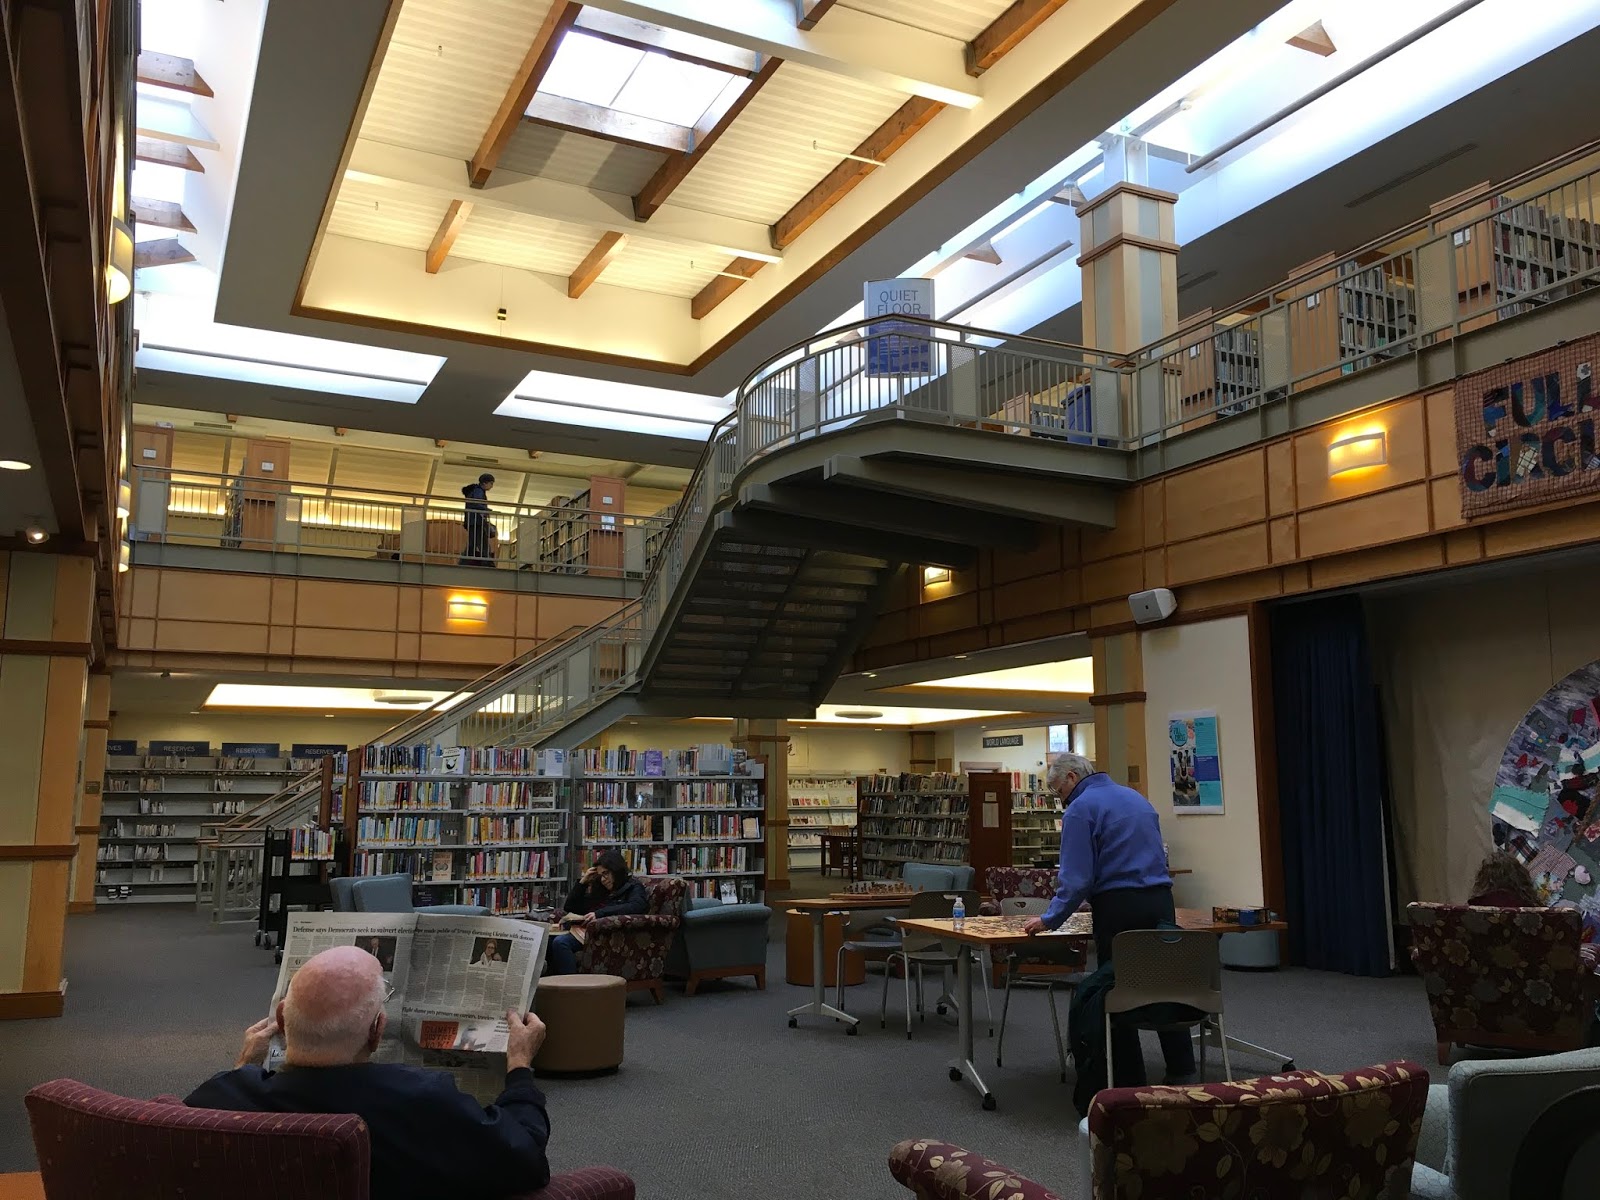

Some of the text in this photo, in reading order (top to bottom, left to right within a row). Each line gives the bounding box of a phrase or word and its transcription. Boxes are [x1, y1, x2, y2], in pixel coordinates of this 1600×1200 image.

[879, 290, 919, 303] QUIET
[877, 303, 922, 315] FLOOR
[1482, 361, 1600, 438] FULL
[986, 737, 1020, 747] WORLD LANGUAGE
[163, 744, 196, 753] RESERVES
[235, 747, 267, 755] RESERVES
[304, 748, 335, 756] RESERVES
